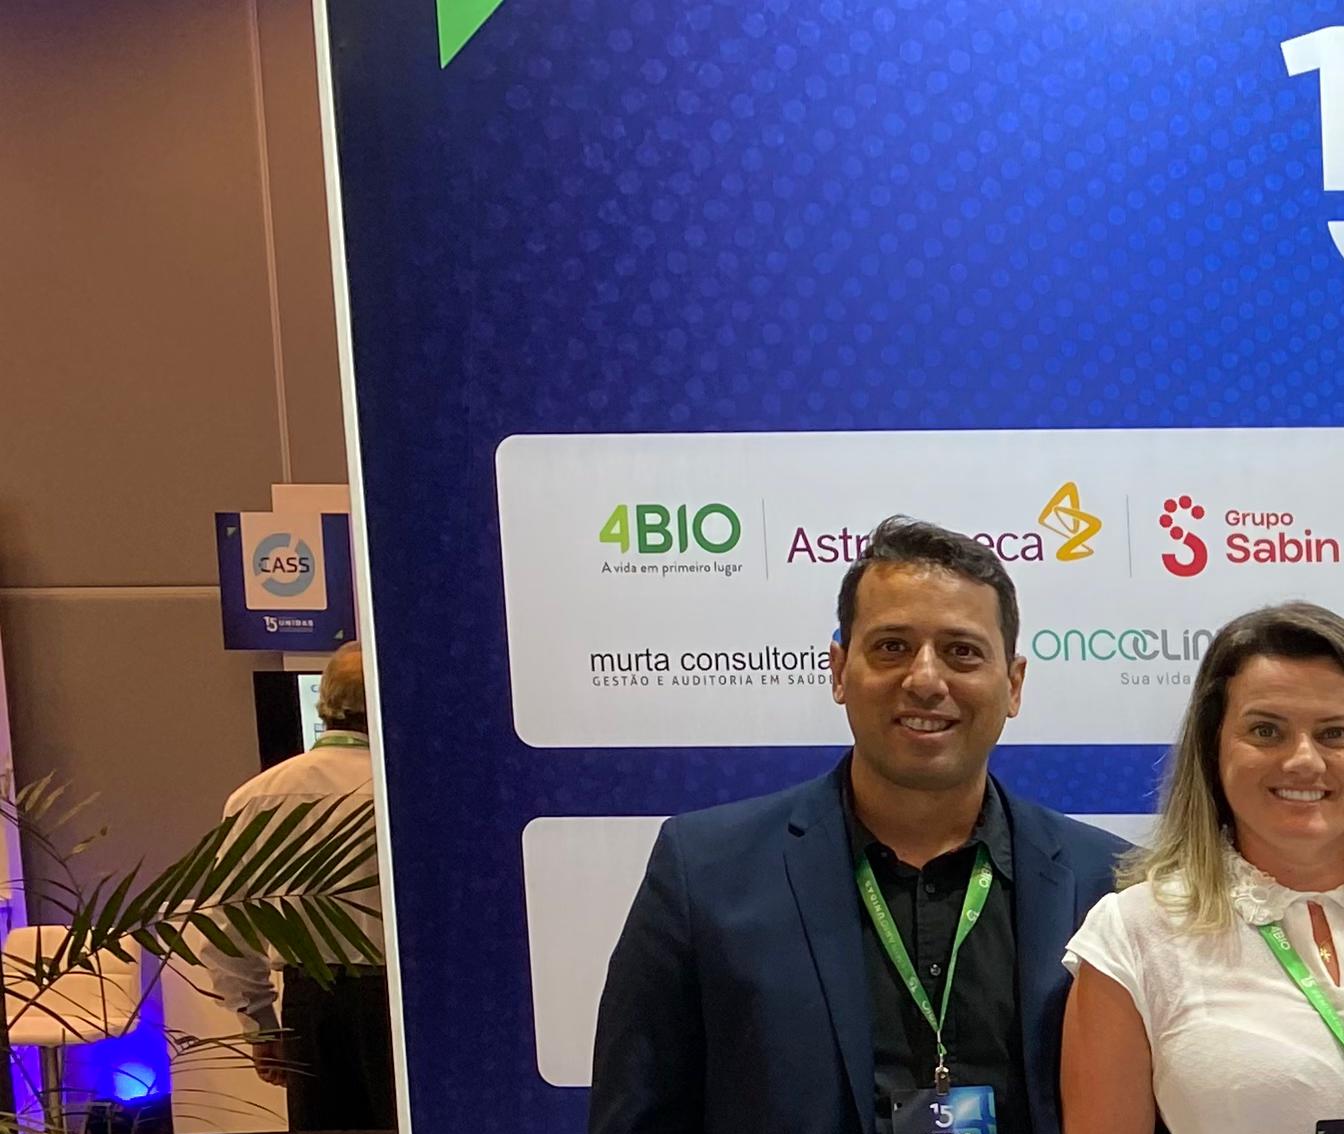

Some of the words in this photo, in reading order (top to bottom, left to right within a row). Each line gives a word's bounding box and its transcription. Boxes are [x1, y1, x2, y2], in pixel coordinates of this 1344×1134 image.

[598, 502, 742, 554] 4BIO
[1225, 509, 1295, 530] Grupo
[1225, 529, 1341, 565] Sabin
[258, 556, 311, 573] CASS
[614, 561, 637, 574] vida
[640, 563, 659, 574] em
[662, 561, 711, 578] primeiro
[713, 561, 743, 577] lugar
[590, 648, 670, 672] murta
[680, 645, 832, 672] consultoria
[592, 673, 650, 687] GESTÃO
[657, 675, 665, 686] E
[671, 674, 754, 686] AUDITORIA
[761, 674, 781, 686] EM
[1120, 672, 1151, 686] Sua
[1156, 671, 1192, 686] vida
